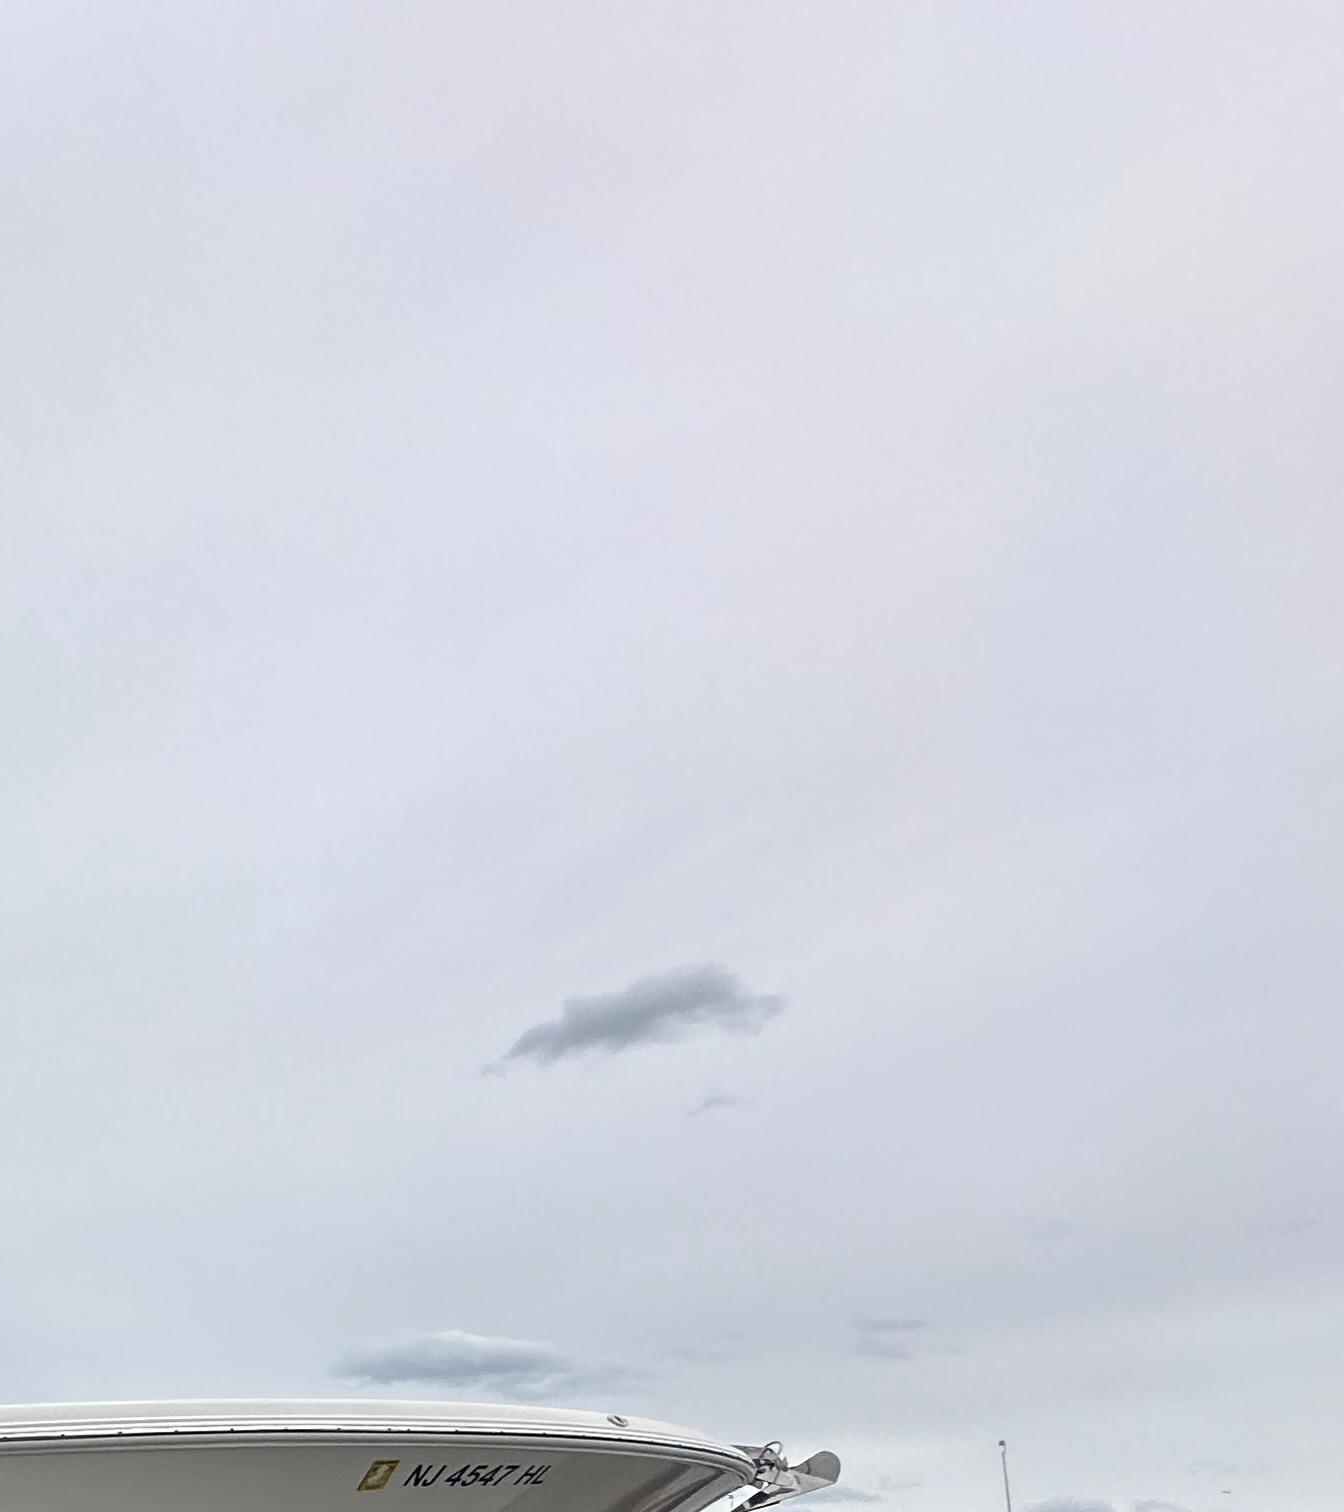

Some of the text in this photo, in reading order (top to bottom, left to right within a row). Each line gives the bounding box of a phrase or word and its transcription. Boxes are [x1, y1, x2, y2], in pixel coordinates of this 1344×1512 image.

[403, 1464, 552, 1487] NJ 4547 HL
